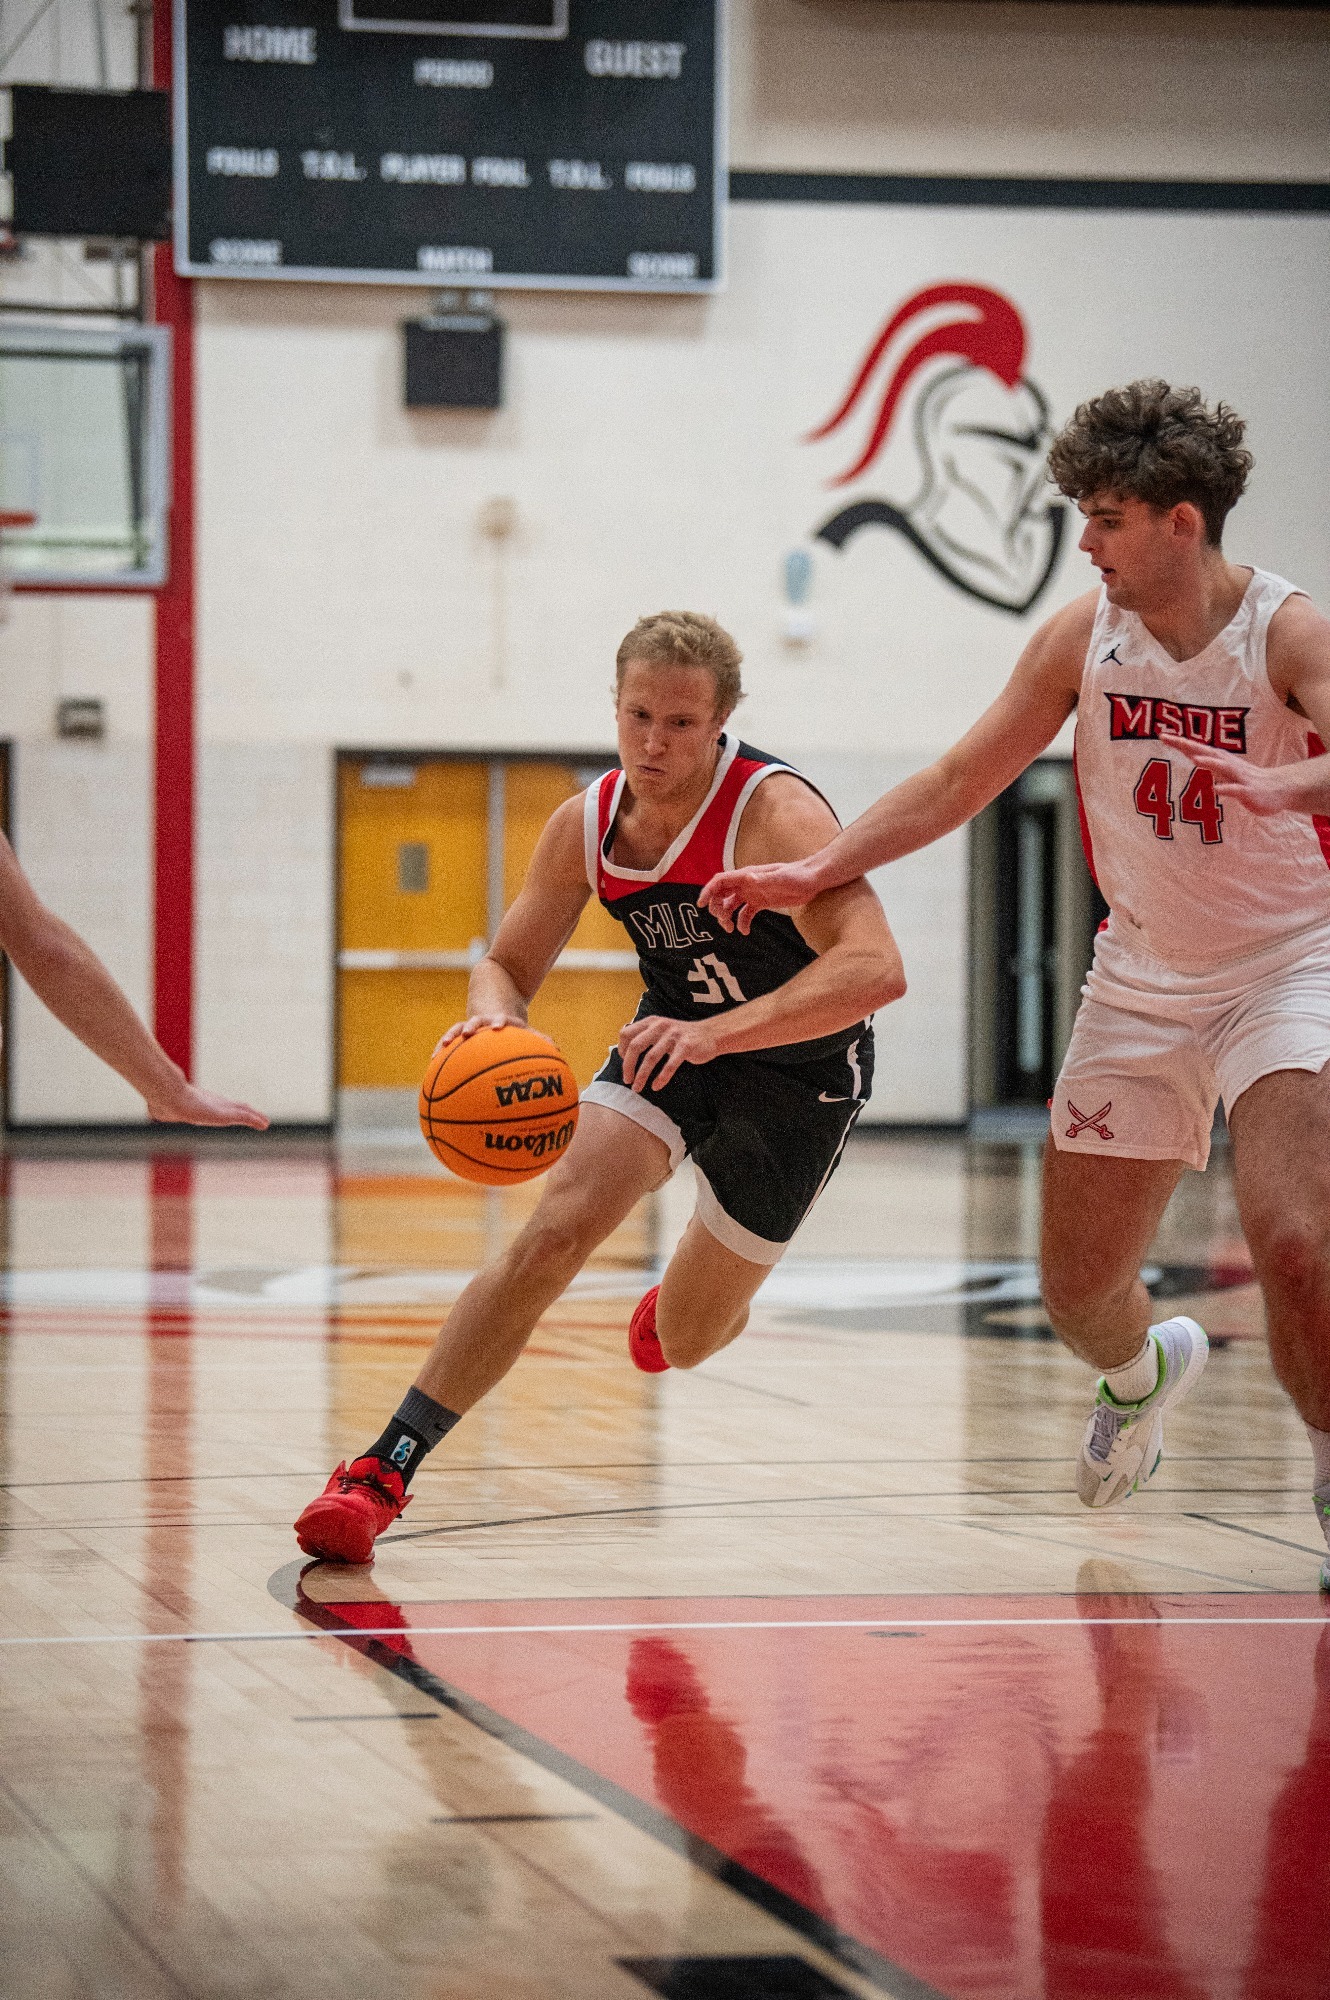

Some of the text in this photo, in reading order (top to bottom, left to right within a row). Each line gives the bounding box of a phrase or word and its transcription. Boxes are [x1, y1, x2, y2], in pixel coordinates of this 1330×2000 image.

[223, 26, 317, 64] HOME
[584, 40, 687, 79] GUEST
[380, 152, 466, 185] PLAYER
[1106, 694, 1250, 752] MSOE
[1134, 758, 1223, 844] 44
[629, 902, 714, 949] MLC
[495, 1074, 564, 1107] NCAA
[485, 1119, 575, 1158] Wilson
